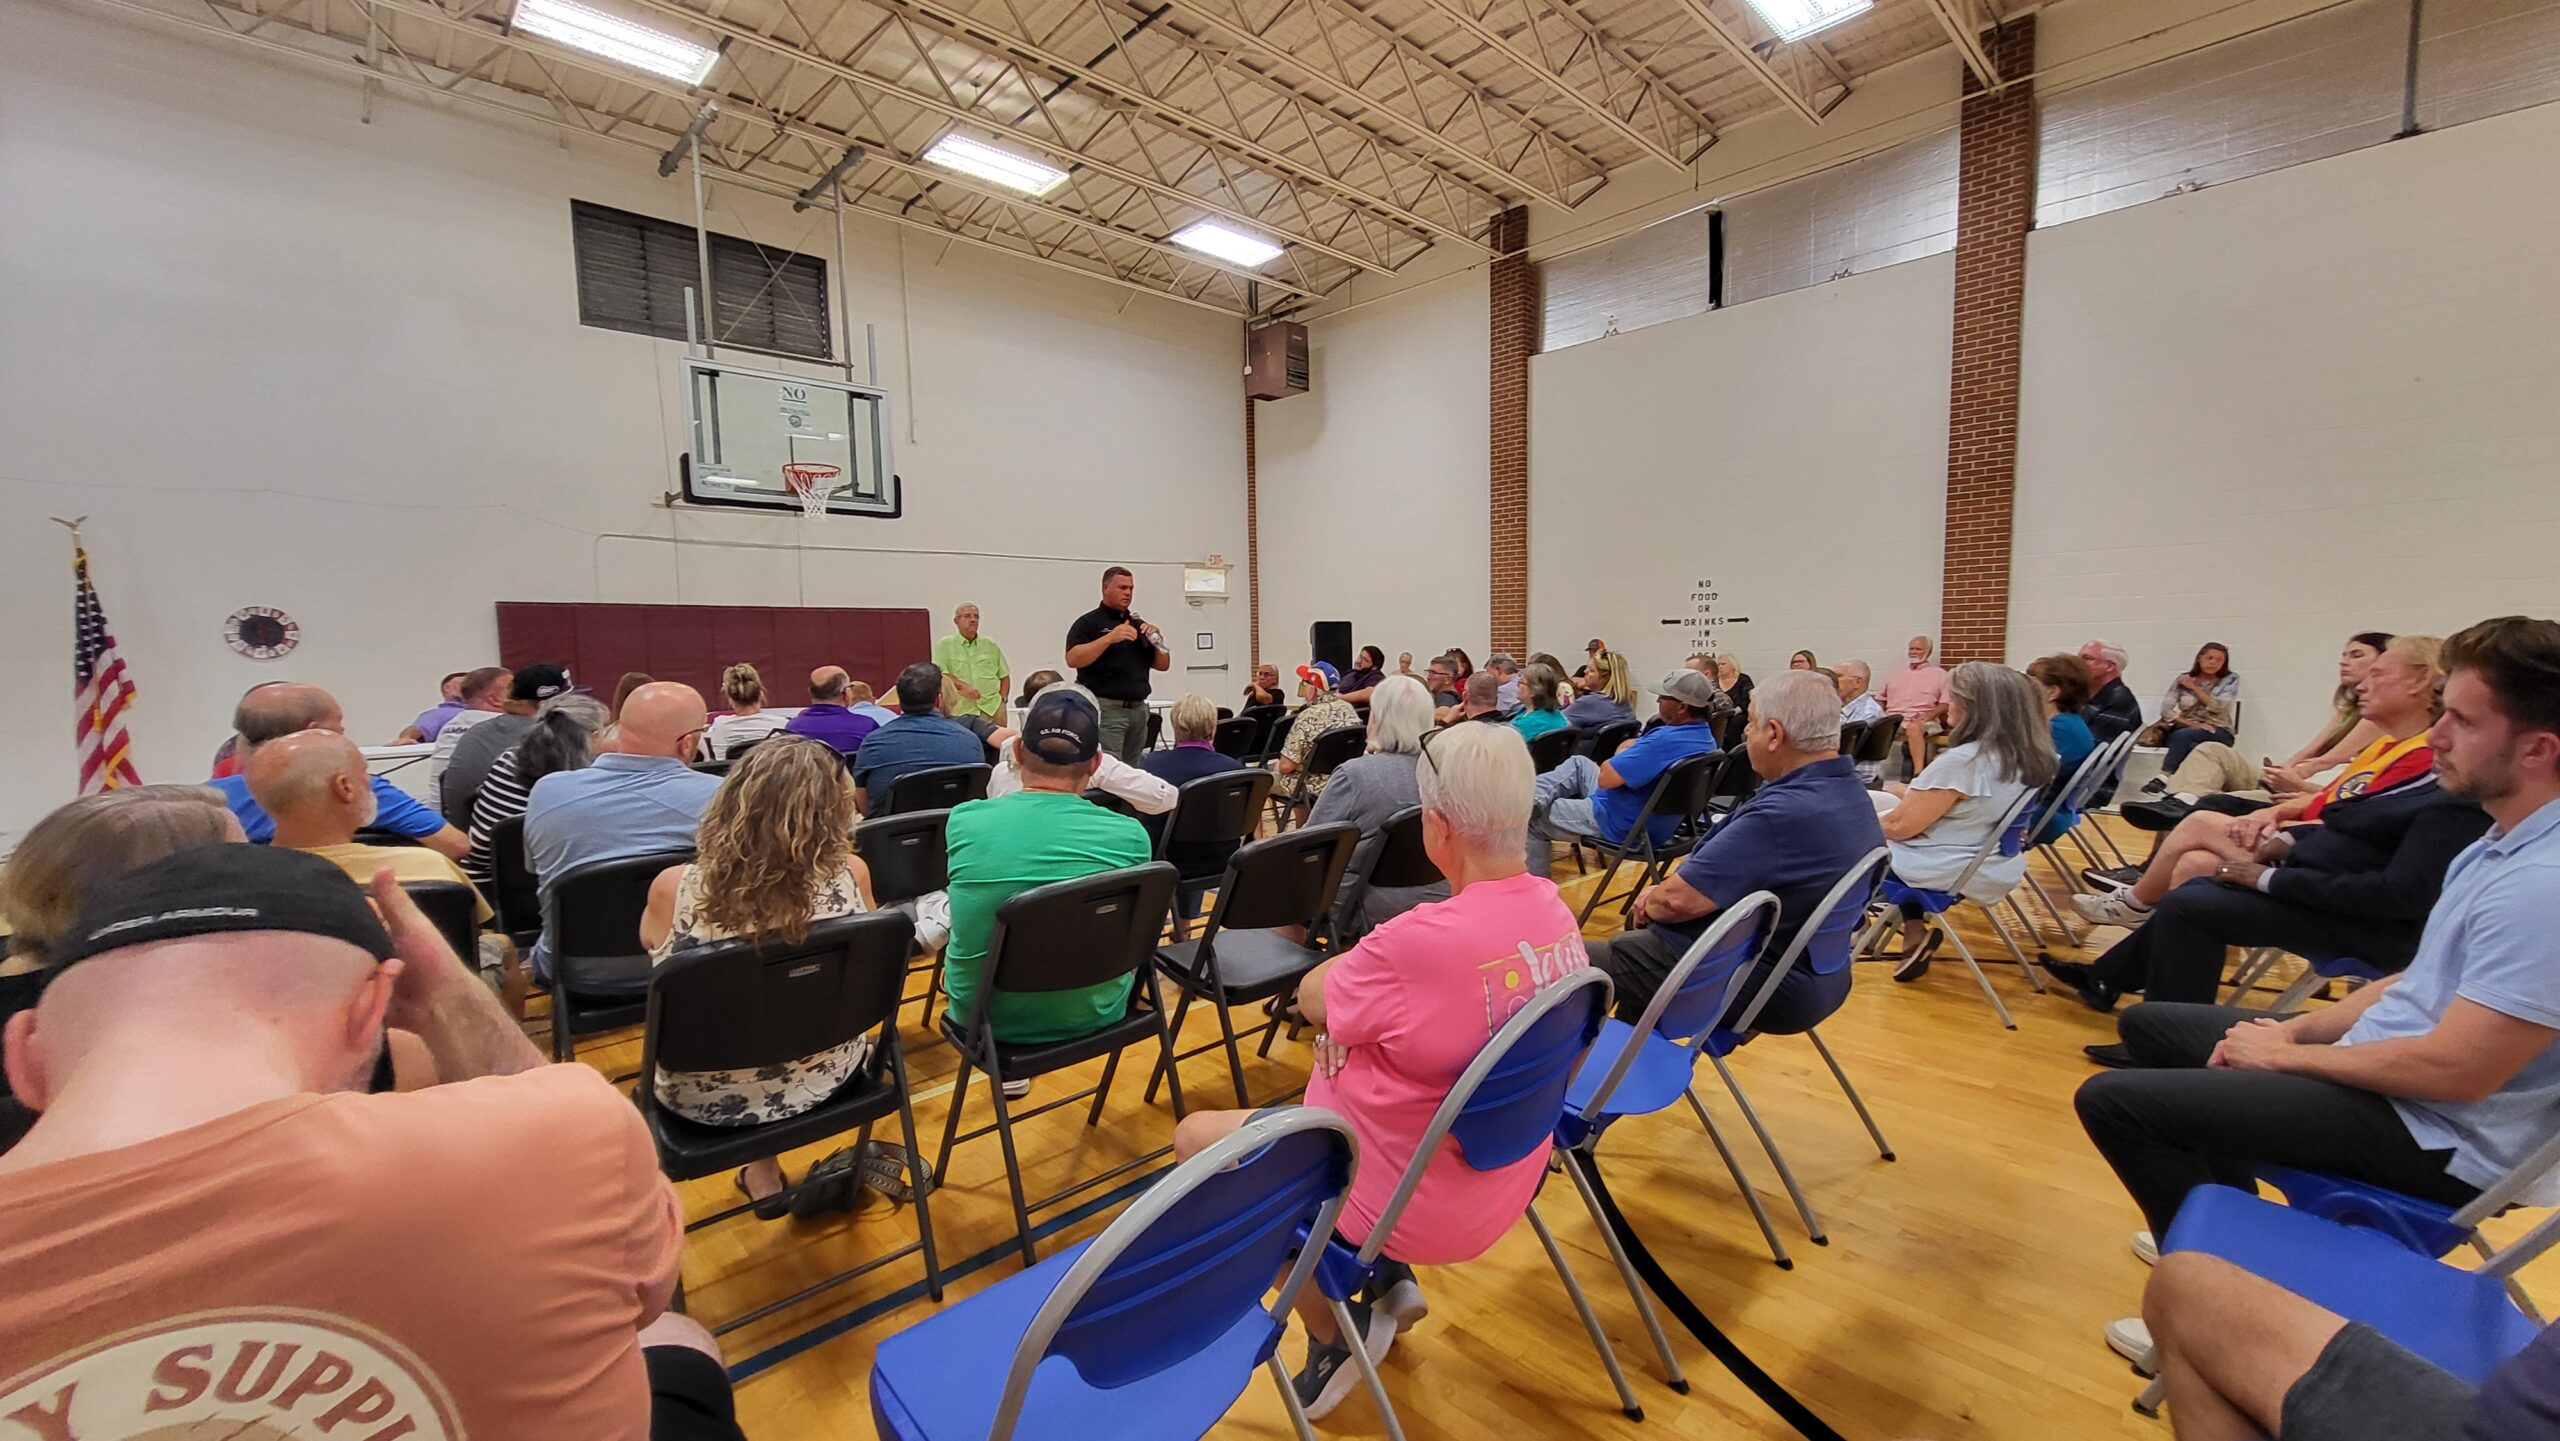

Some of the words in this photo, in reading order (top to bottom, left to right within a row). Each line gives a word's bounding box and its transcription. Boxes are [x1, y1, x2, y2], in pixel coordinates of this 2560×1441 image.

[782, 385, 806, 400] NO
[1698, 580, 1711, 588] NO
[1691, 592, 1718, 601] FOOD
[1697, 604, 1710, 612] OR
[1684, 617, 1724, 626] DRINKS
[1698, 629, 1710, 637] IN
[1691, 640, 1717, 648] THIS
